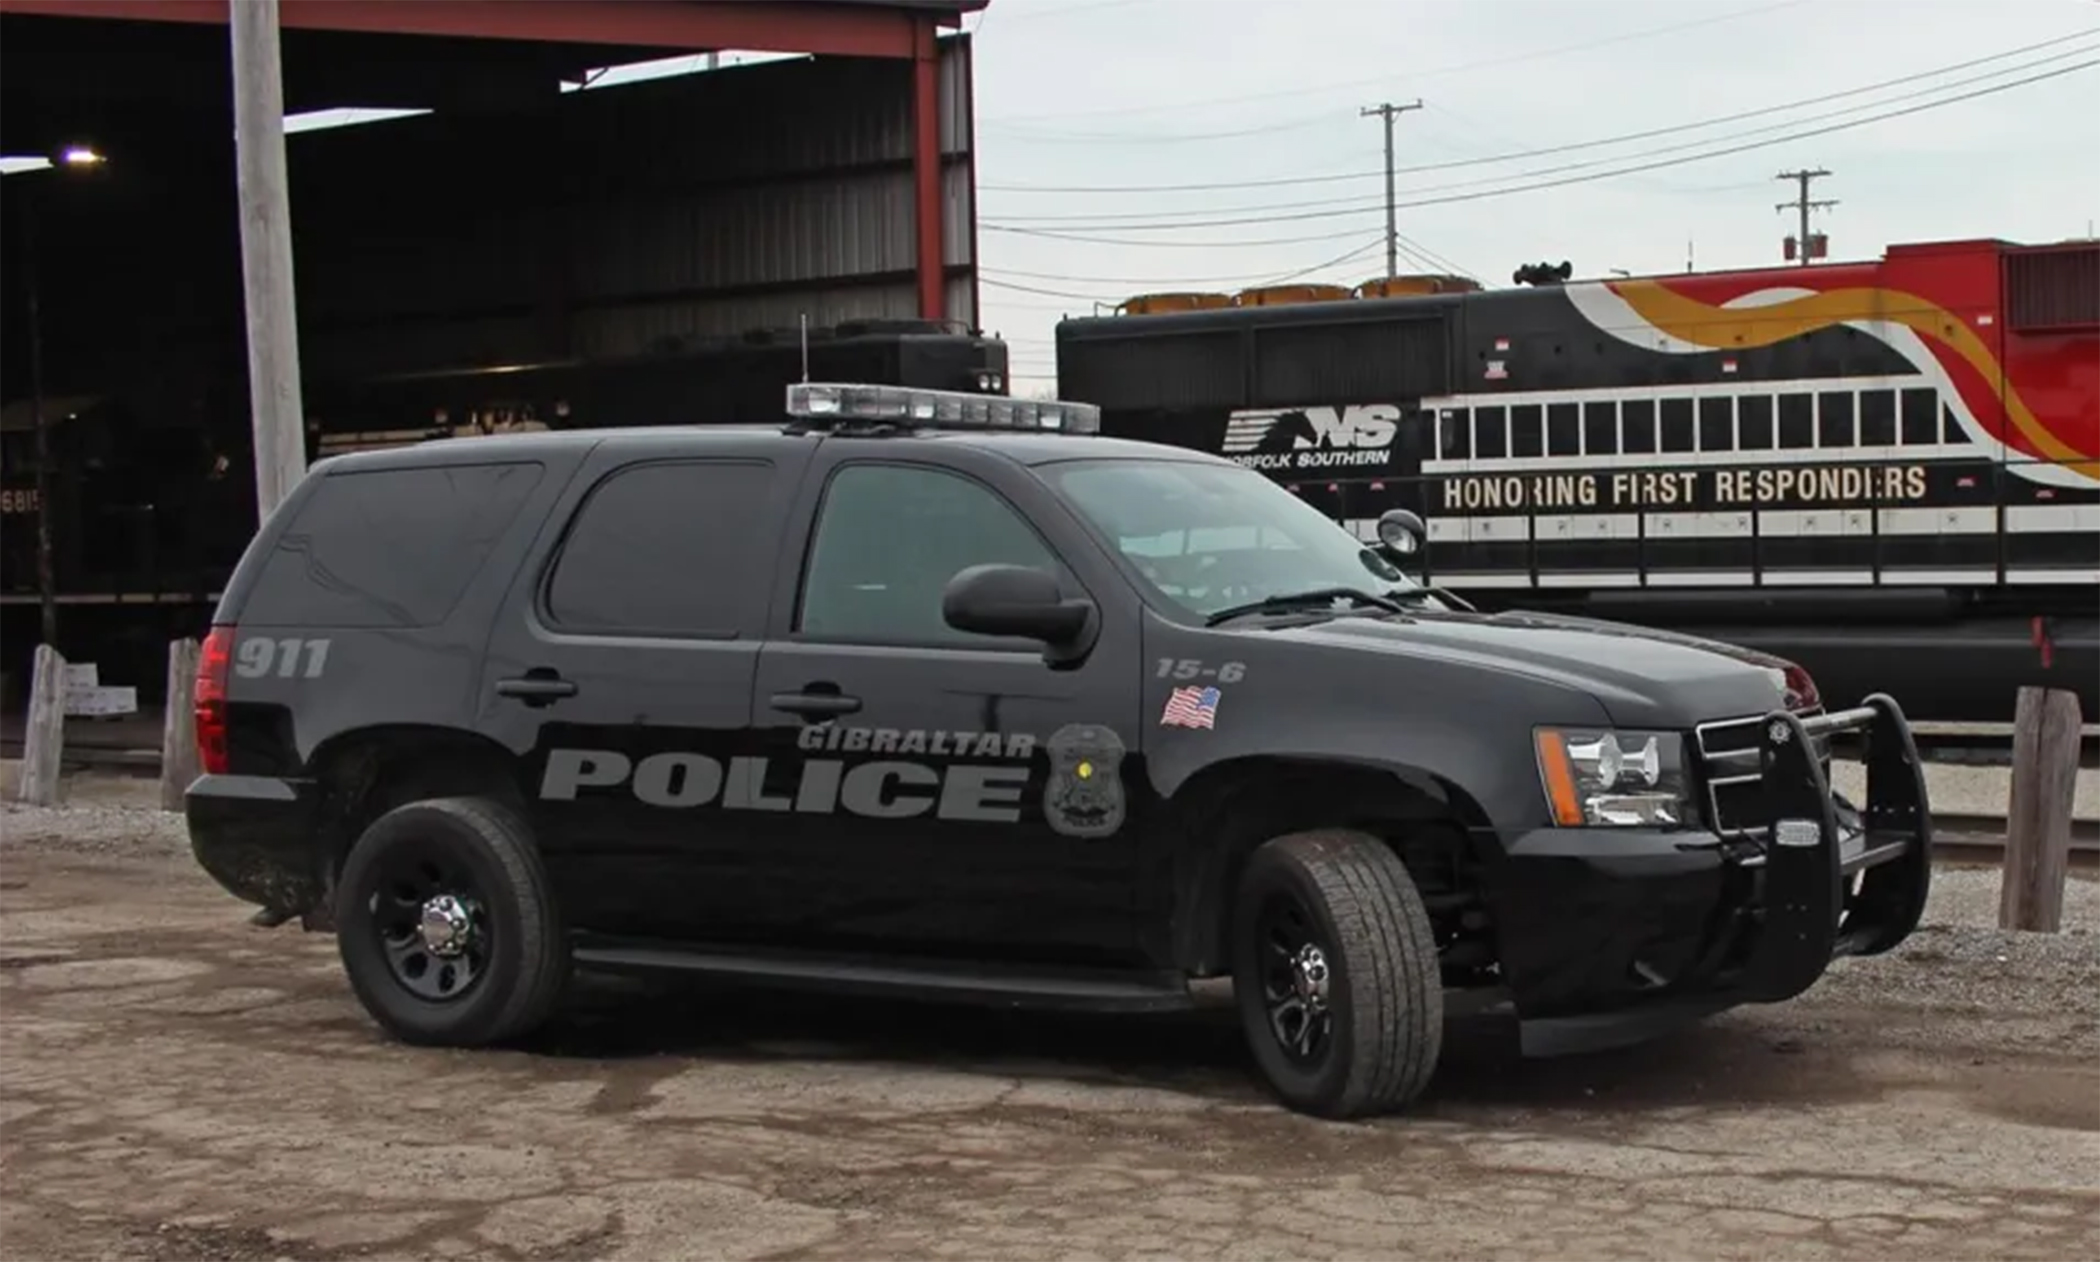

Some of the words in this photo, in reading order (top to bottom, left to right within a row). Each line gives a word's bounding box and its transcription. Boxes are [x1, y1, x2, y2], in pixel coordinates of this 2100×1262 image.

[1226, 453, 1292, 469] ORFOLK
[1297, 450, 1391, 467] SOUTHERN
[1444, 475, 1596, 508] HONORING
[1613, 472, 1697, 504] FIRST
[1715, 466, 1926, 502] RESPONDERS
[235, 637, 331, 678] 911
[1157, 658, 1246, 682] 15-6
[797, 724, 1036, 758] GIBRALTAR
[538, 748, 1031, 822] POLICE
